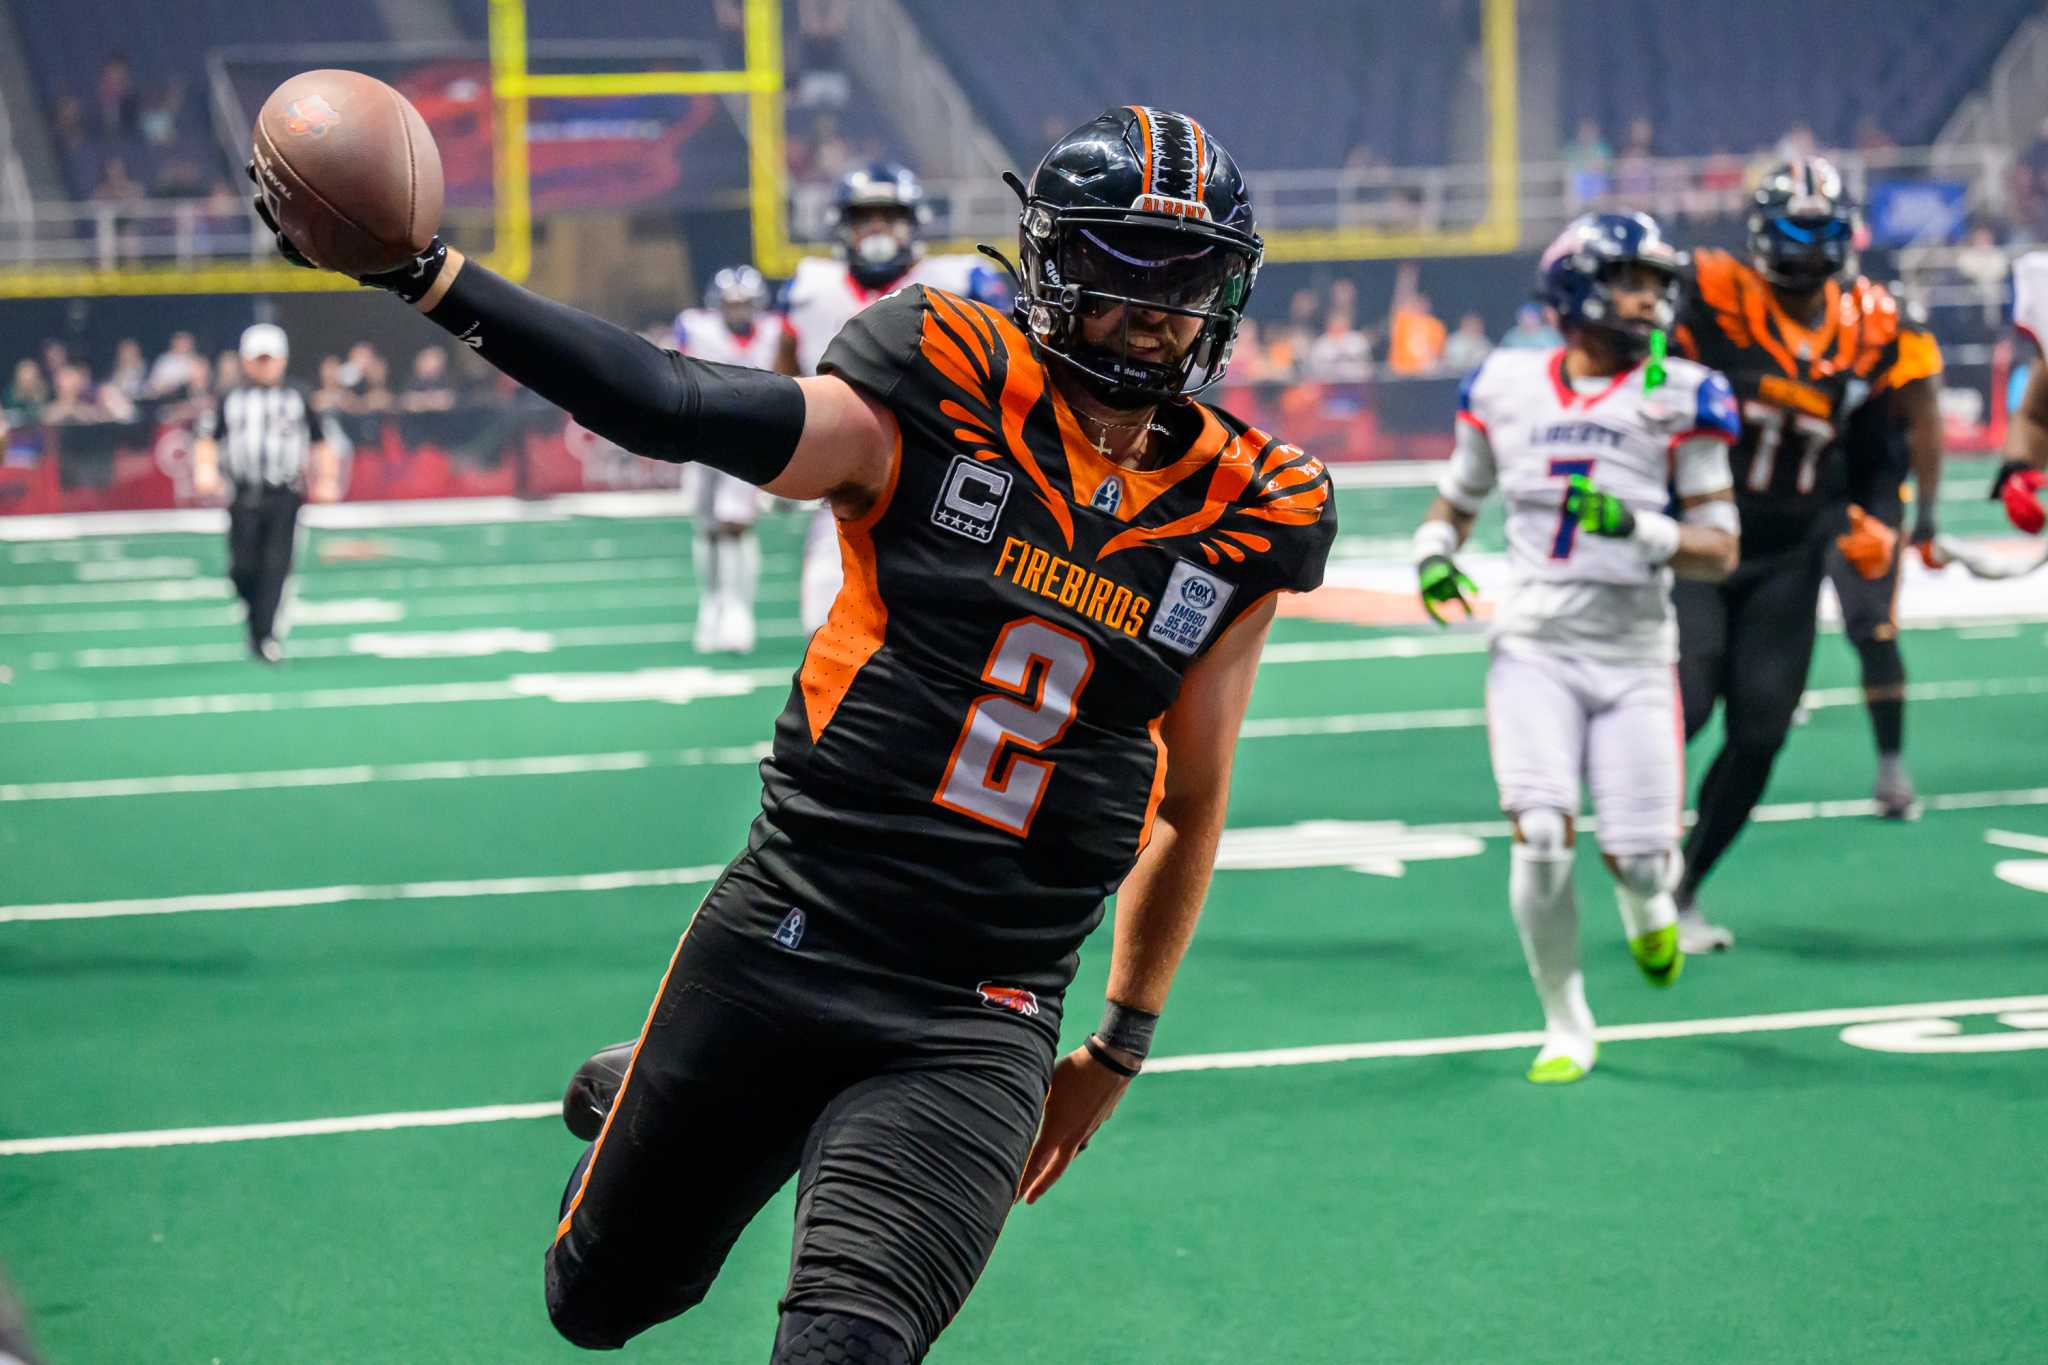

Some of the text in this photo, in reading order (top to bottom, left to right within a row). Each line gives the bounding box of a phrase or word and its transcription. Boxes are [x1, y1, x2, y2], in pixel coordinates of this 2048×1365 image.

[1113, 363, 1147, 380] Rddell
[1743, 399, 1836, 494] 77
[945, 461, 1007, 522] C
[1548, 457, 1595, 560] 7
[993, 535, 1151, 638] FIREBIRDS
[1169, 602, 1208, 627] AM980
[1188, 580, 1211, 601] FOX
[1163, 615, 1203, 640] 95.9FM
[932, 614, 1096, 839] 2
